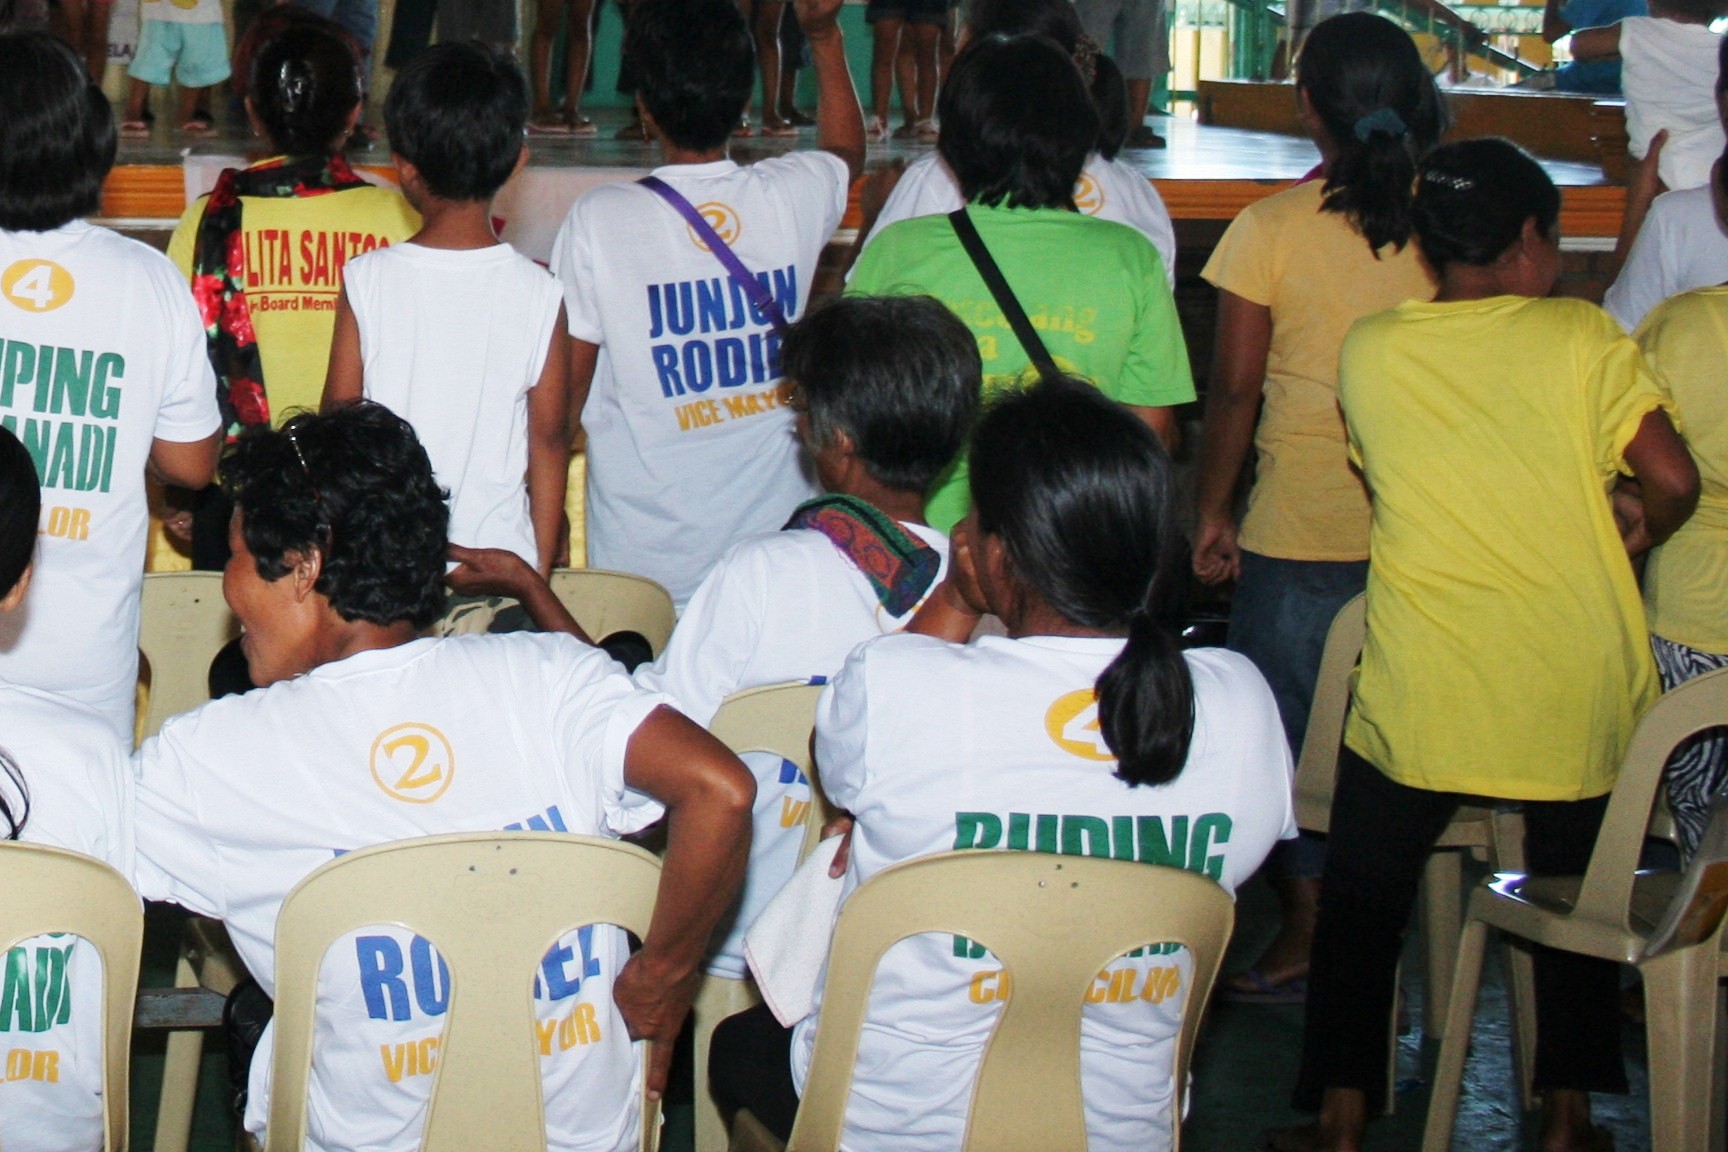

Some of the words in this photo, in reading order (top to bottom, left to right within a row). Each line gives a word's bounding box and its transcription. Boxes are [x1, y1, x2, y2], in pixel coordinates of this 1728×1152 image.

[11, 265, 55, 309] 4
[260, 295, 299, 312] Board
[674, 399, 725, 432] VICE
[382, 734, 443, 791] 2
